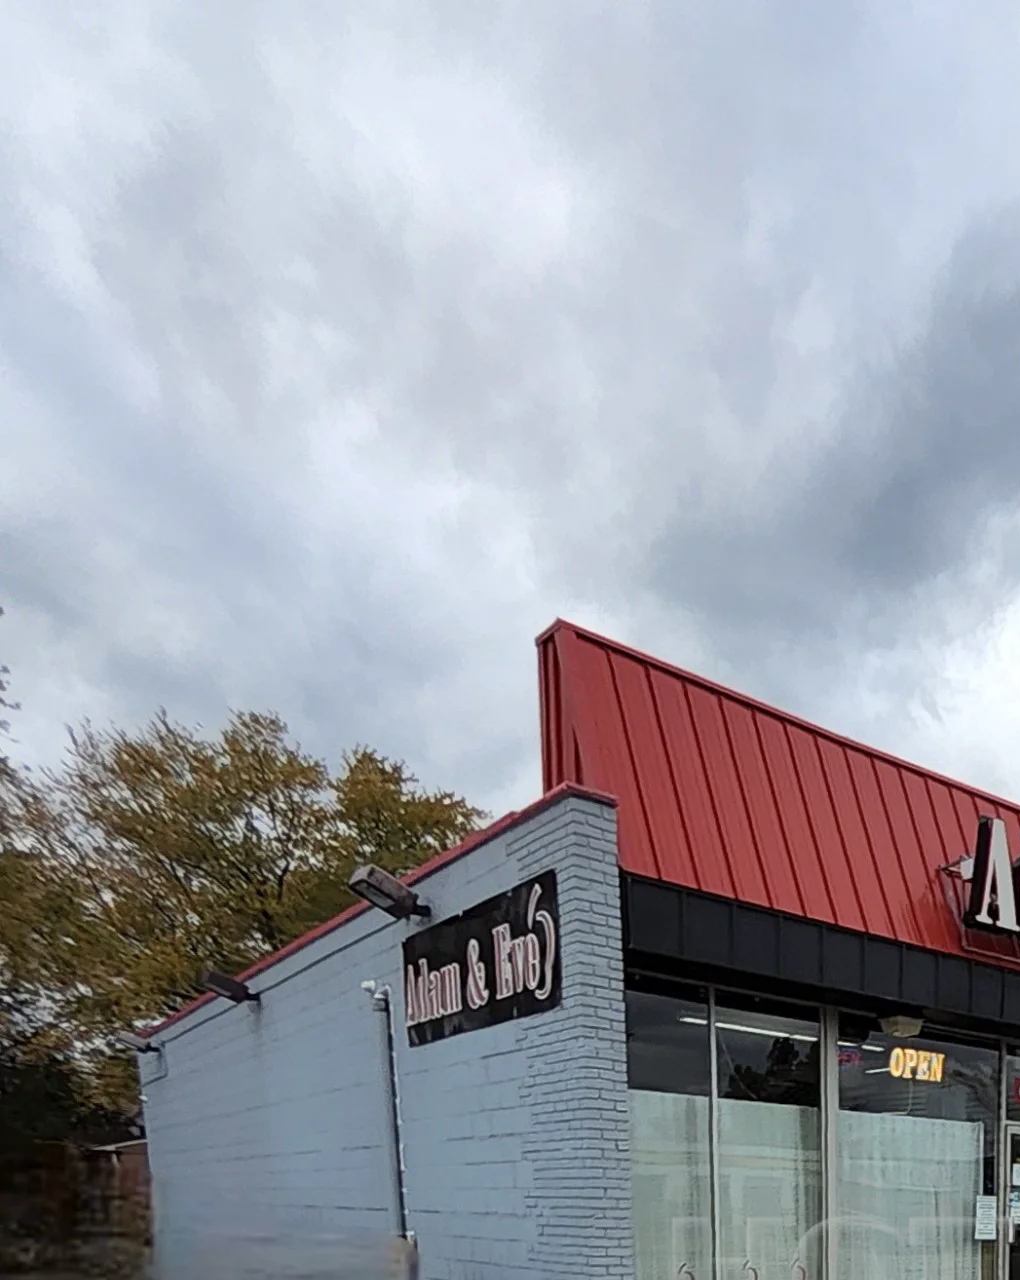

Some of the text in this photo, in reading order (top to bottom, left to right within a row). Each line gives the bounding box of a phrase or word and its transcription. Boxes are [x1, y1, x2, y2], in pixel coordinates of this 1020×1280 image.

[405, 922, 541, 1027] Adam & Eve
[889, 1046, 946, 1083] OPEN
